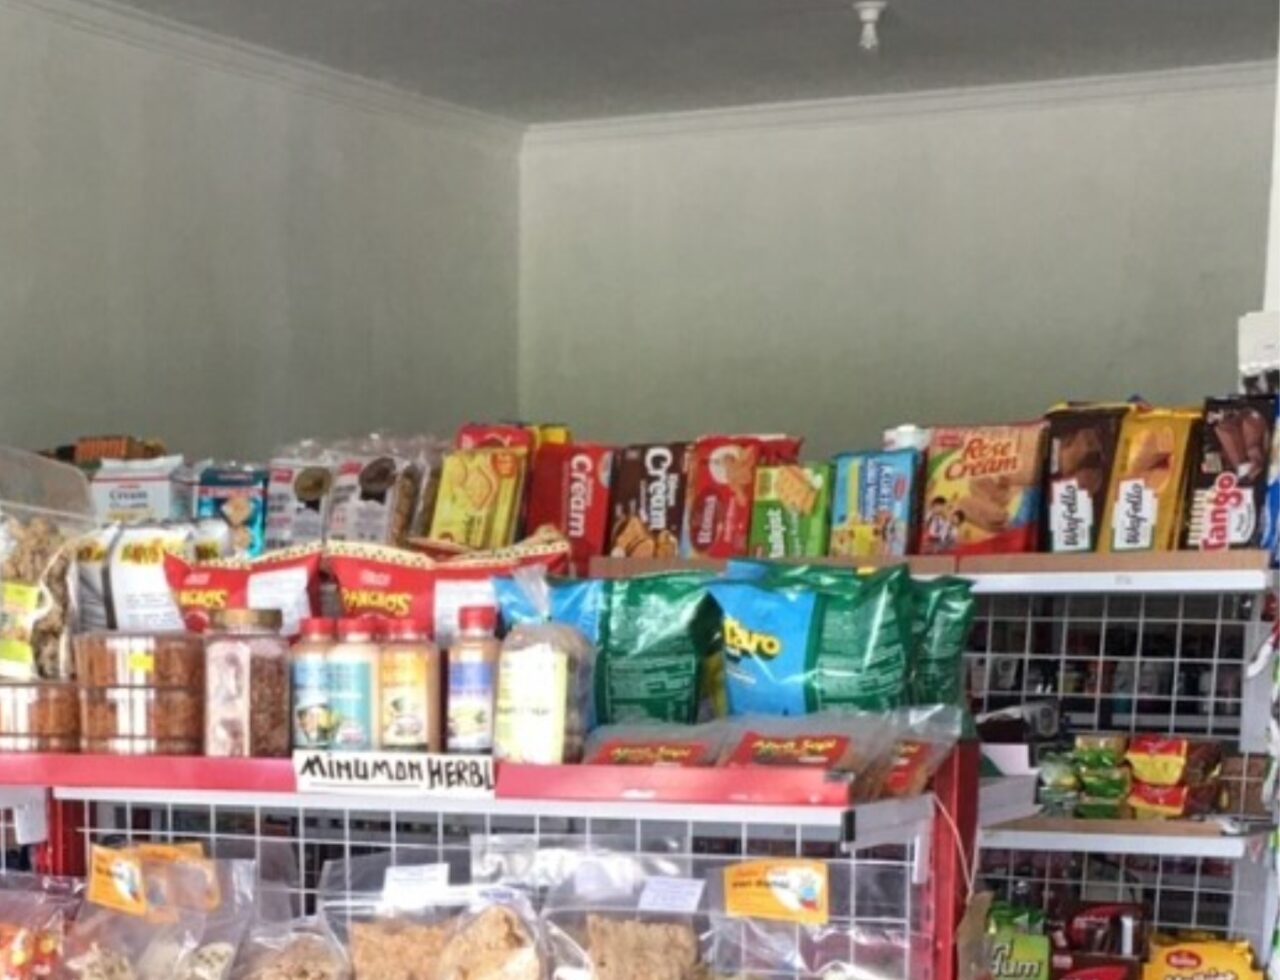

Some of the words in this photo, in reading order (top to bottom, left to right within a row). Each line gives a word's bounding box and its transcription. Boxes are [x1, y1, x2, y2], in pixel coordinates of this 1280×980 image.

[944, 455, 1018, 482] Cream
[963, 437, 1013, 459] Rose
[568, 454, 593, 537] Cream
[645, 447, 673, 529] Cream
[1060, 484, 1083, 546] Wafello
[1124, 482, 1147, 544] Wafello
[1203, 473, 1243, 551] Tango
